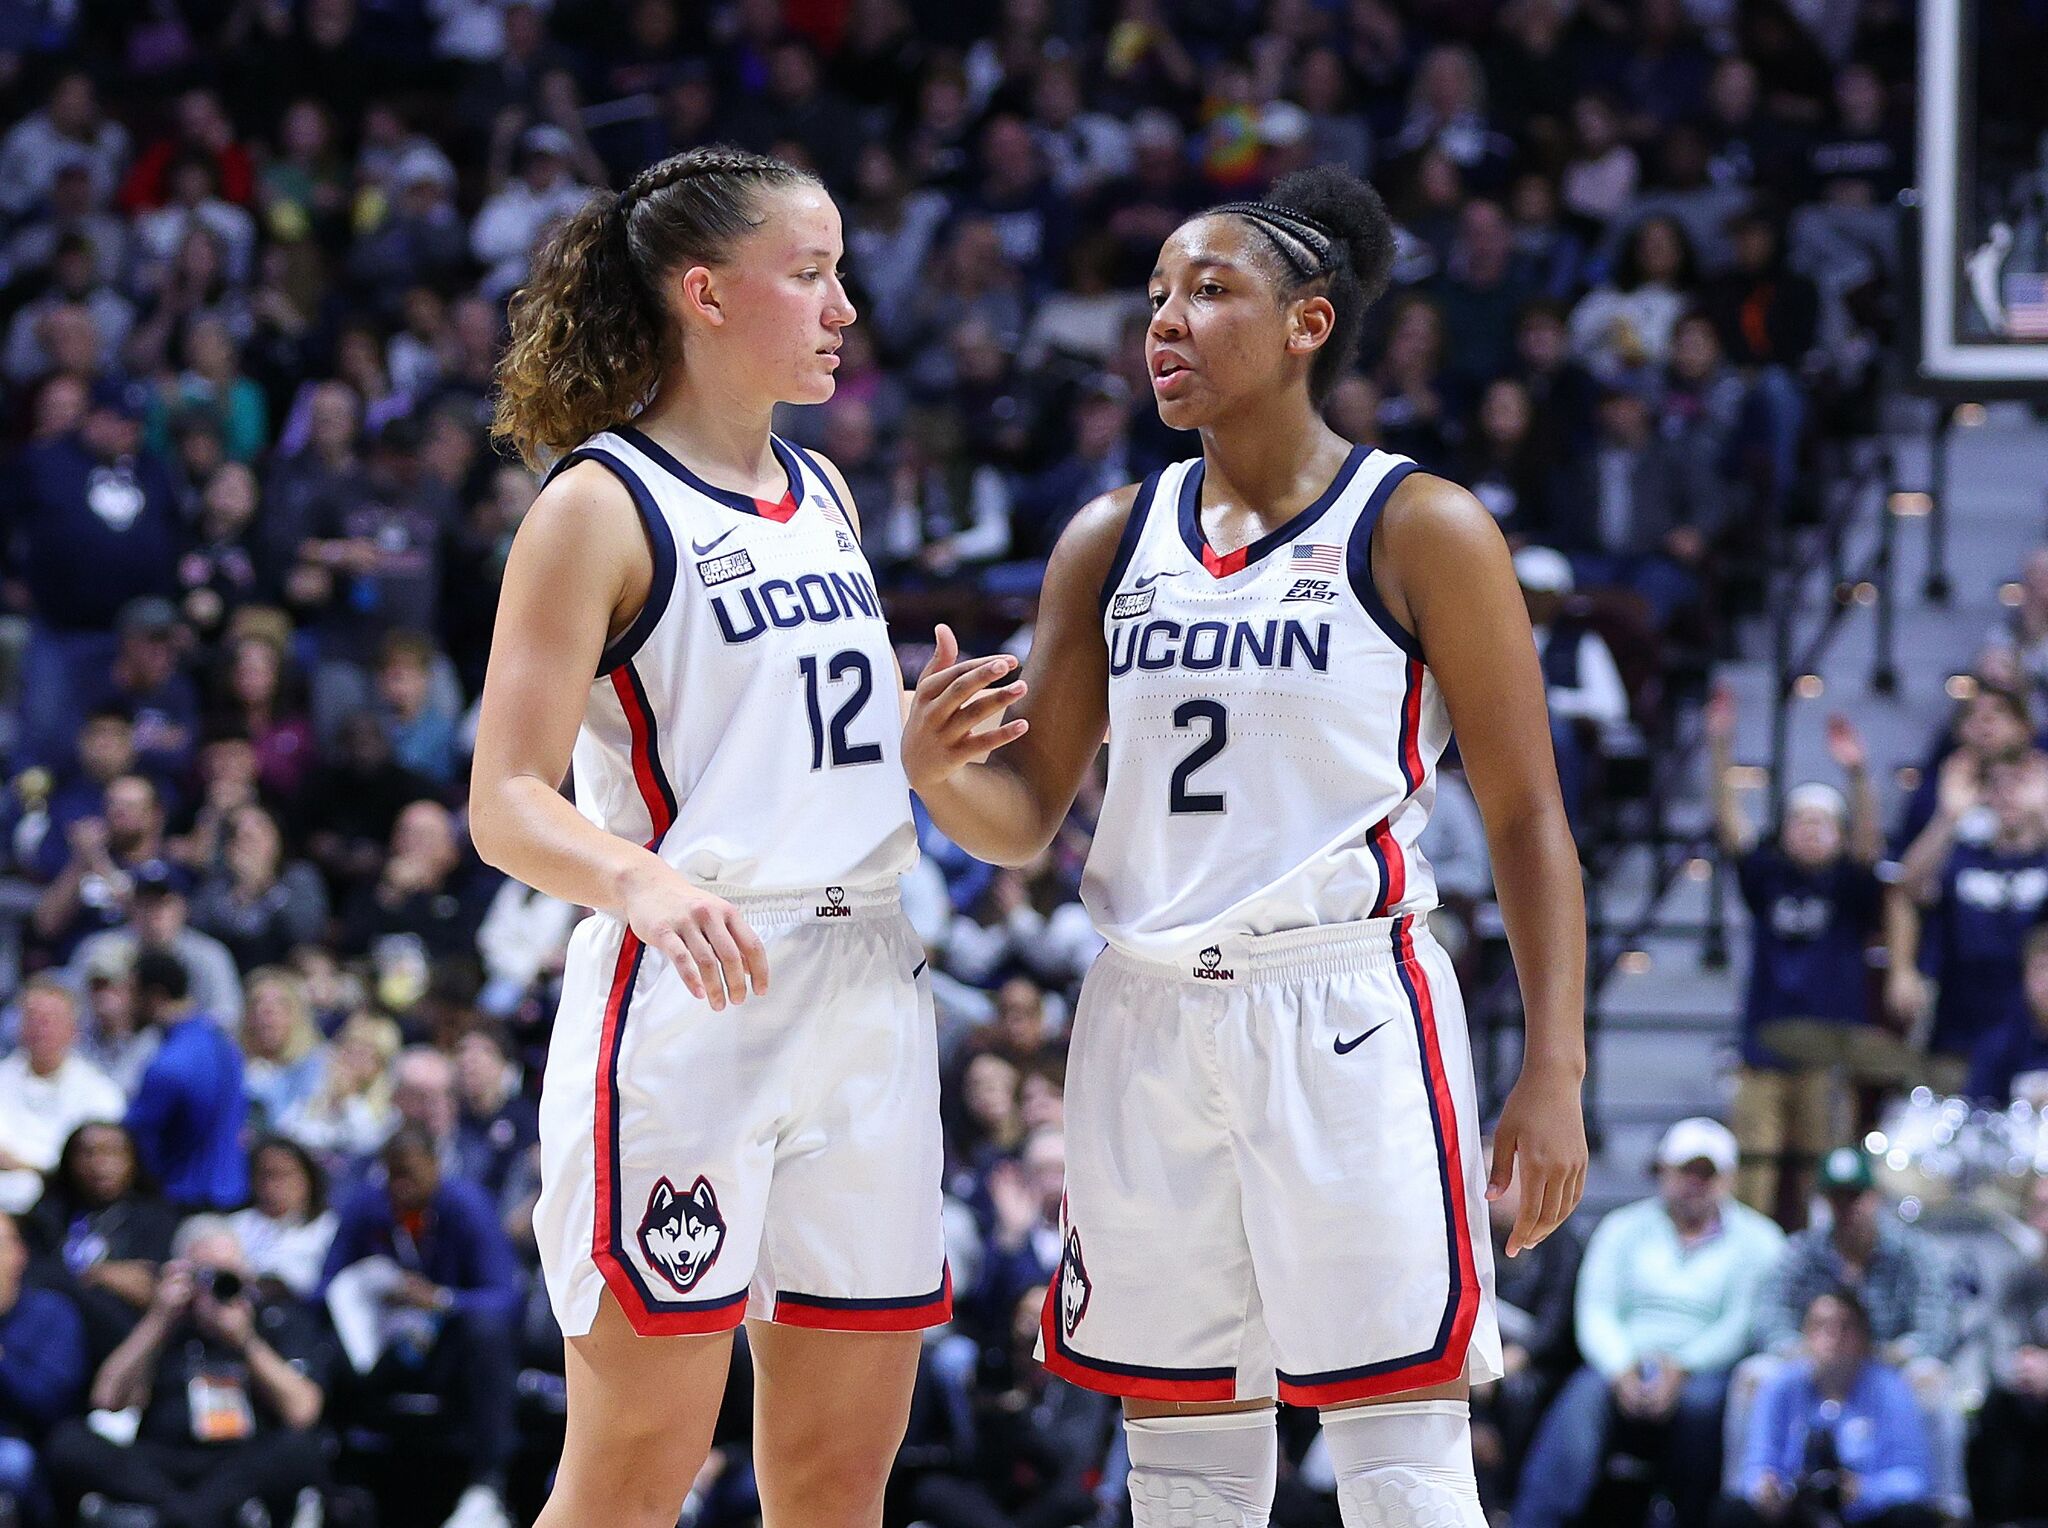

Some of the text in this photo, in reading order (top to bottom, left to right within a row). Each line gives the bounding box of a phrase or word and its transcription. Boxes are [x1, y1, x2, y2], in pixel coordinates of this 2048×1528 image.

[708, 550, 749, 573] BE THE
[704, 562, 753, 584] CHANGE
[1293, 579, 1331, 590] BIG
[1285, 589, 1339, 600] EAST
[1114, 603, 1150, 617] CHANG
[1110, 619, 1331, 679] UCONN
[797, 648, 884, 773] 12
[1169, 697, 1227, 816] 2
[816, 905, 851, 917] UCONN
[1193, 967, 1234, 980] UCONN
